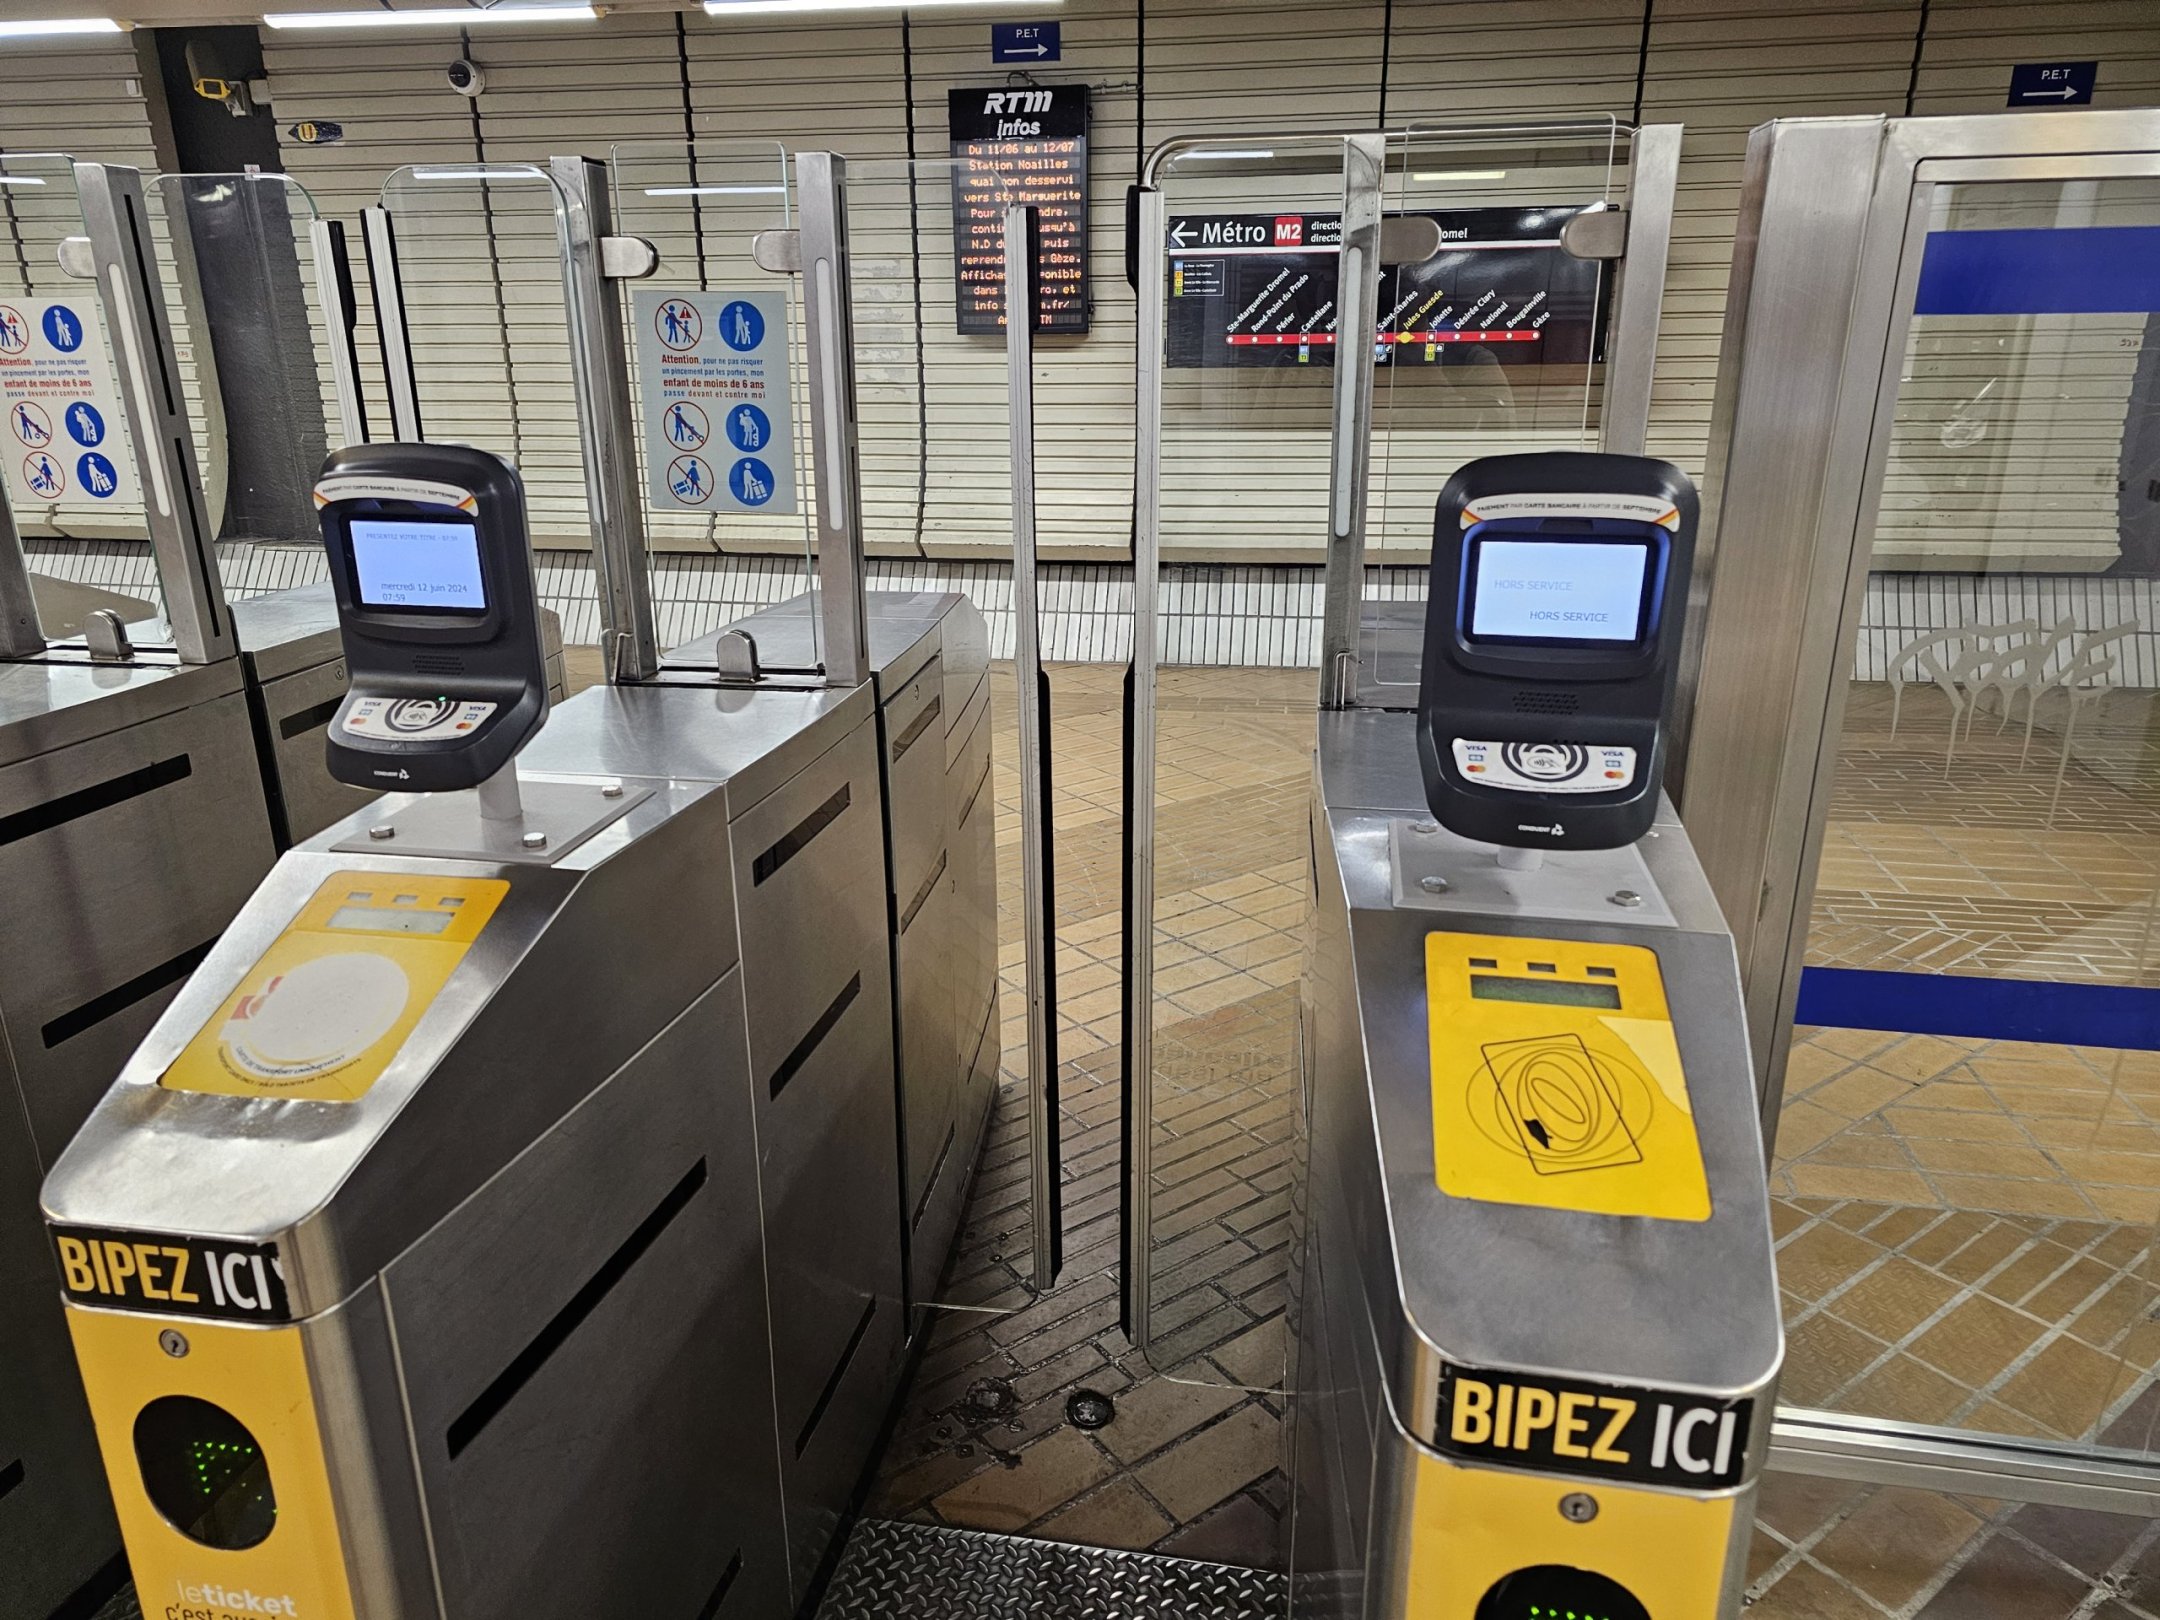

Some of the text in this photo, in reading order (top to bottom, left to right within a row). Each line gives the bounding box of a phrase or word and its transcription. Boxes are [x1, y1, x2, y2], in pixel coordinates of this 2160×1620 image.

[1015, 28, 1040, 38] P.E.T
[2041, 68, 2072, 80] P.E.T
[983, 90, 1053, 114] RTM
[997, 118, 1041, 136] infos
[968, 142, 1075, 155] Du 11/06 au 12/07
[969, 158, 1069, 171] Station Noailles
[969, 177, 994, 187] quai
[1024, 174, 1074, 185] desservi
[964, 193, 990, 203] vers
[1018, 190, 1081, 202] Marguerite
[970, 208, 996, 218] Pour
[1039, 222, 1076, 233] usqu'à
[1202, 221, 1267, 244] Métro
[1276, 224, 1302, 240] M2
[1311, 221, 1342, 231] directio
[971, 239, 991, 249] N.D
[1044, 238, 1070, 248] puis
[1310, 233, 1342, 243] directio
[1050, 253, 1081, 264] Gèze.
[973, 285, 998, 296] dans
[1062, 284, 1076, 295] et
[974, 300, 999, 311] info
[1226, 266, 1291, 333] Ste-Marguerite Dromel
[1250, 274, 1309, 333] Rond-Point du Prado
[1301, 300, 1333, 332] Castellane
[1377, 290, 1419, 331] Saint-Charles
[1403, 289, 1444, 330] Jules Guesde
[1453, 289, 1496, 330] Désirée Clary
[1480, 301, 1509, 329] National
[1506, 290, 1547, 329] Bougainville
[1275, 312, 1296, 333] Périer
[1428, 305, 1454, 330] Joliette
[1532, 311, 1551, 329] Gèze
[703, 358, 718, 366] pour
[727, 358, 739, 366] pas
[740, 357, 764, 366] risquer
[670, 367, 703, 376] pincement
[704, 369, 715, 377] par
[716, 368, 725, 376] les
[4, 379, 92, 388] enfant de moins de 6 ans
[663, 377, 765, 389] enfant de moins de 6 ans
[663, 390, 685, 398] passe
[688, 389, 712, 398] devant
[725, 390, 748, 398] contre
[751, 391, 766, 399] moi
[380, 582, 468, 593] mercredi 12 juin 2024
[1494, 579, 1573, 591] HORS SERVICE
[382, 593, 406, 602] 07:59
[1529, 611, 1609, 622] HORS SERVICE
[57, 1235, 273, 1310] BIPEZ ICI
[1450, 1377, 1737, 1475] BIPEZ ICI
